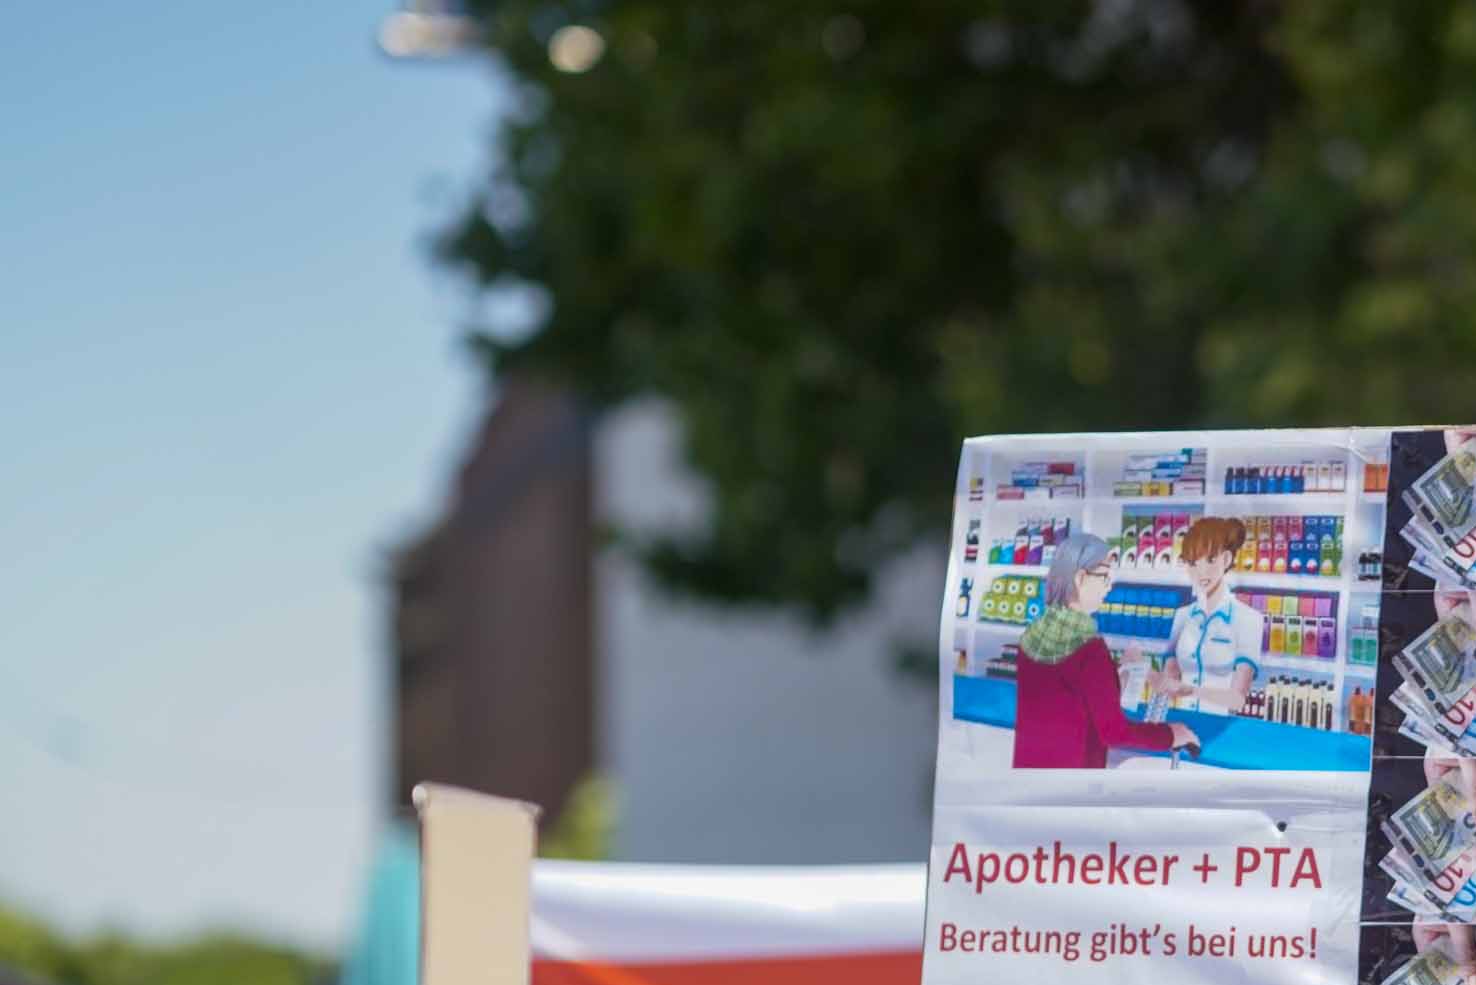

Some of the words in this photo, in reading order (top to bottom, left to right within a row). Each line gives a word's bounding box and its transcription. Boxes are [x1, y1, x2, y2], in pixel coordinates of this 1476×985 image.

[1445, 700, 1473, 725] 10
[943, 841, 1178, 894] Apotheker
[1194, 854, 1217, 884] +
[1235, 847, 1322, 889] PTA
[1433, 865, 1463, 892] 10
[939, 923, 1080, 961] Beratung
[1090, 924, 1177, 962] gibt’s
[1188, 926, 1235, 957] bei
[1248, 928, 1317, 959] uns!
